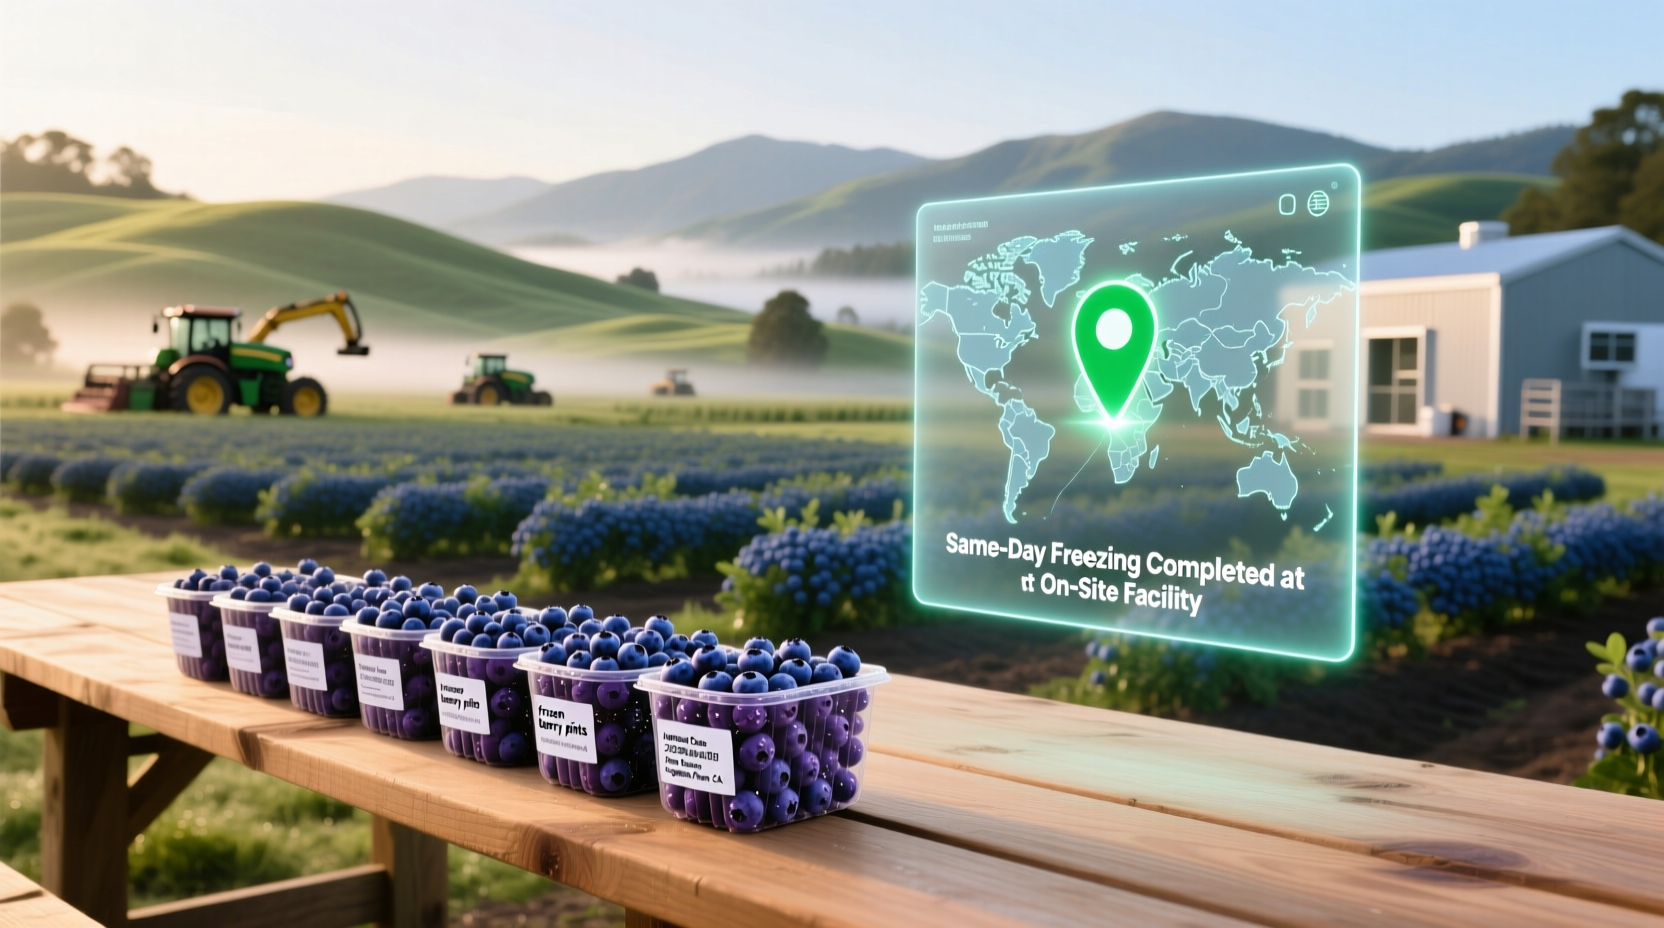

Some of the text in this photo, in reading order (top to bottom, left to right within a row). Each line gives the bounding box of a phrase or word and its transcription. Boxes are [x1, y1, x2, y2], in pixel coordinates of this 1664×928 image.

[945, 531, 1306, 591] Same-Day Freezing Completed at
[1040, 572, 1119, 602] On-Site
[1123, 581, 1203, 617] Facility
